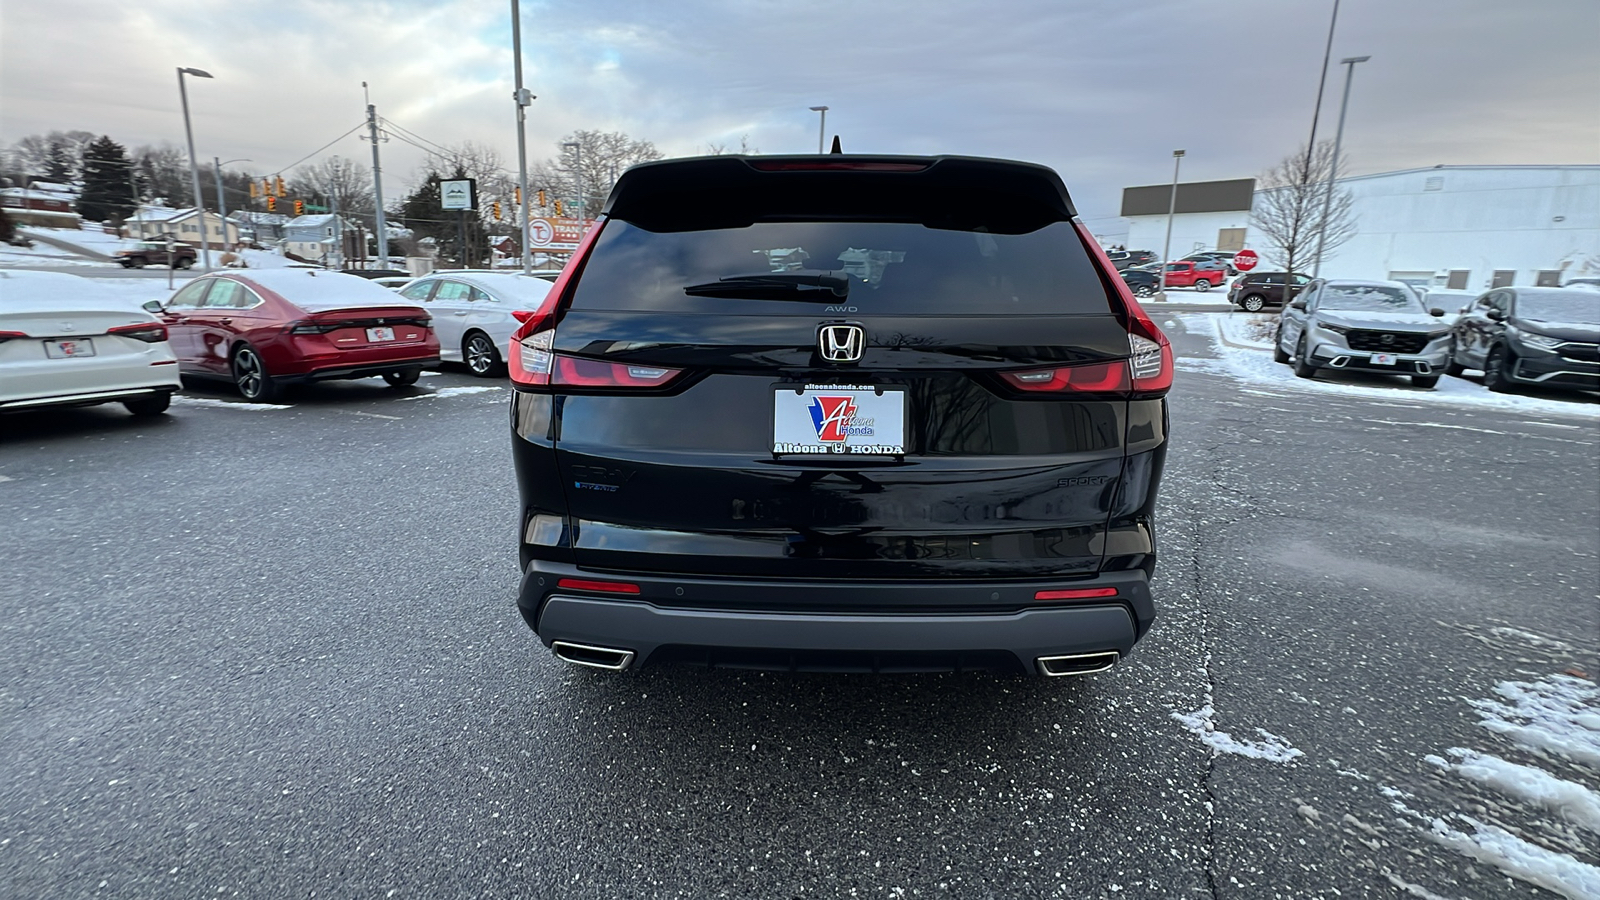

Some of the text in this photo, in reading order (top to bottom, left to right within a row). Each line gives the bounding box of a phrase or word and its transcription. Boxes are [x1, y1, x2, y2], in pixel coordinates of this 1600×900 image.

[1234, 255, 1258, 265] STOP
[804, 383, 875, 391] altoonahonda.com
[841, 425, 874, 435] Honda
[773, 442, 828, 454] Altoona
[850, 444, 905, 454] HONDA
[1057, 475, 1109, 487] SPORT
